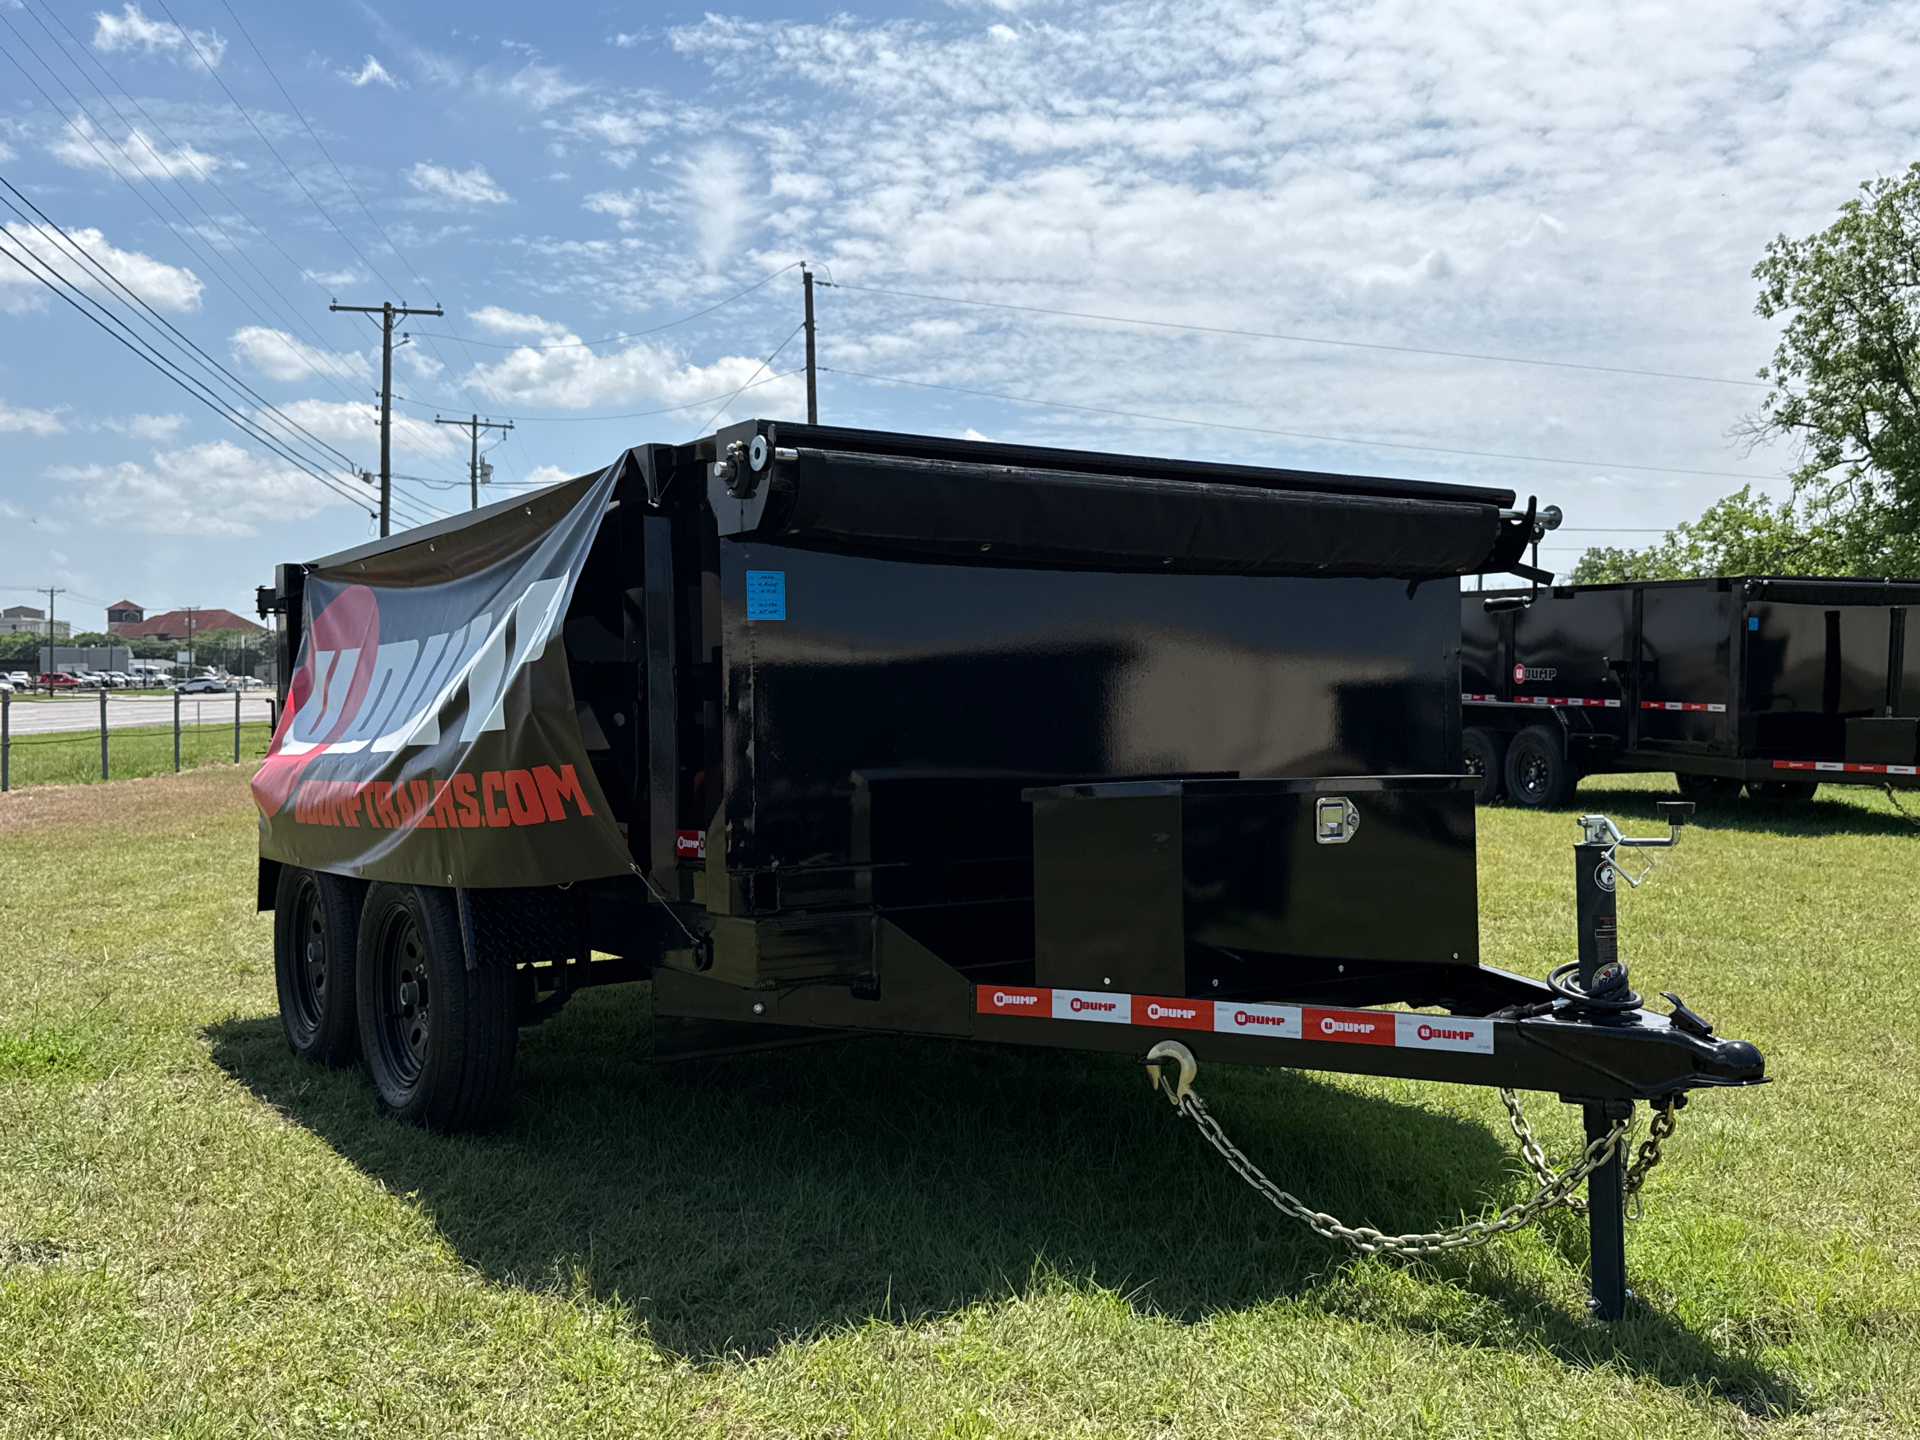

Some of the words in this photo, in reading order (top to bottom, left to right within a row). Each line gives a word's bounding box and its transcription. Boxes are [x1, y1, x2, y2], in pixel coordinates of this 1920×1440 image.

[993, 991, 1038, 1007] UDUMP
[1070, 997, 1116, 1013] UDUMP
[1147, 1003, 1197, 1020] UDUMP
[1234, 1010, 1285, 1027] UDUMP
[1320, 1017, 1375, 1035] UDUMP
[1417, 1024, 1474, 1041] UDUMP
